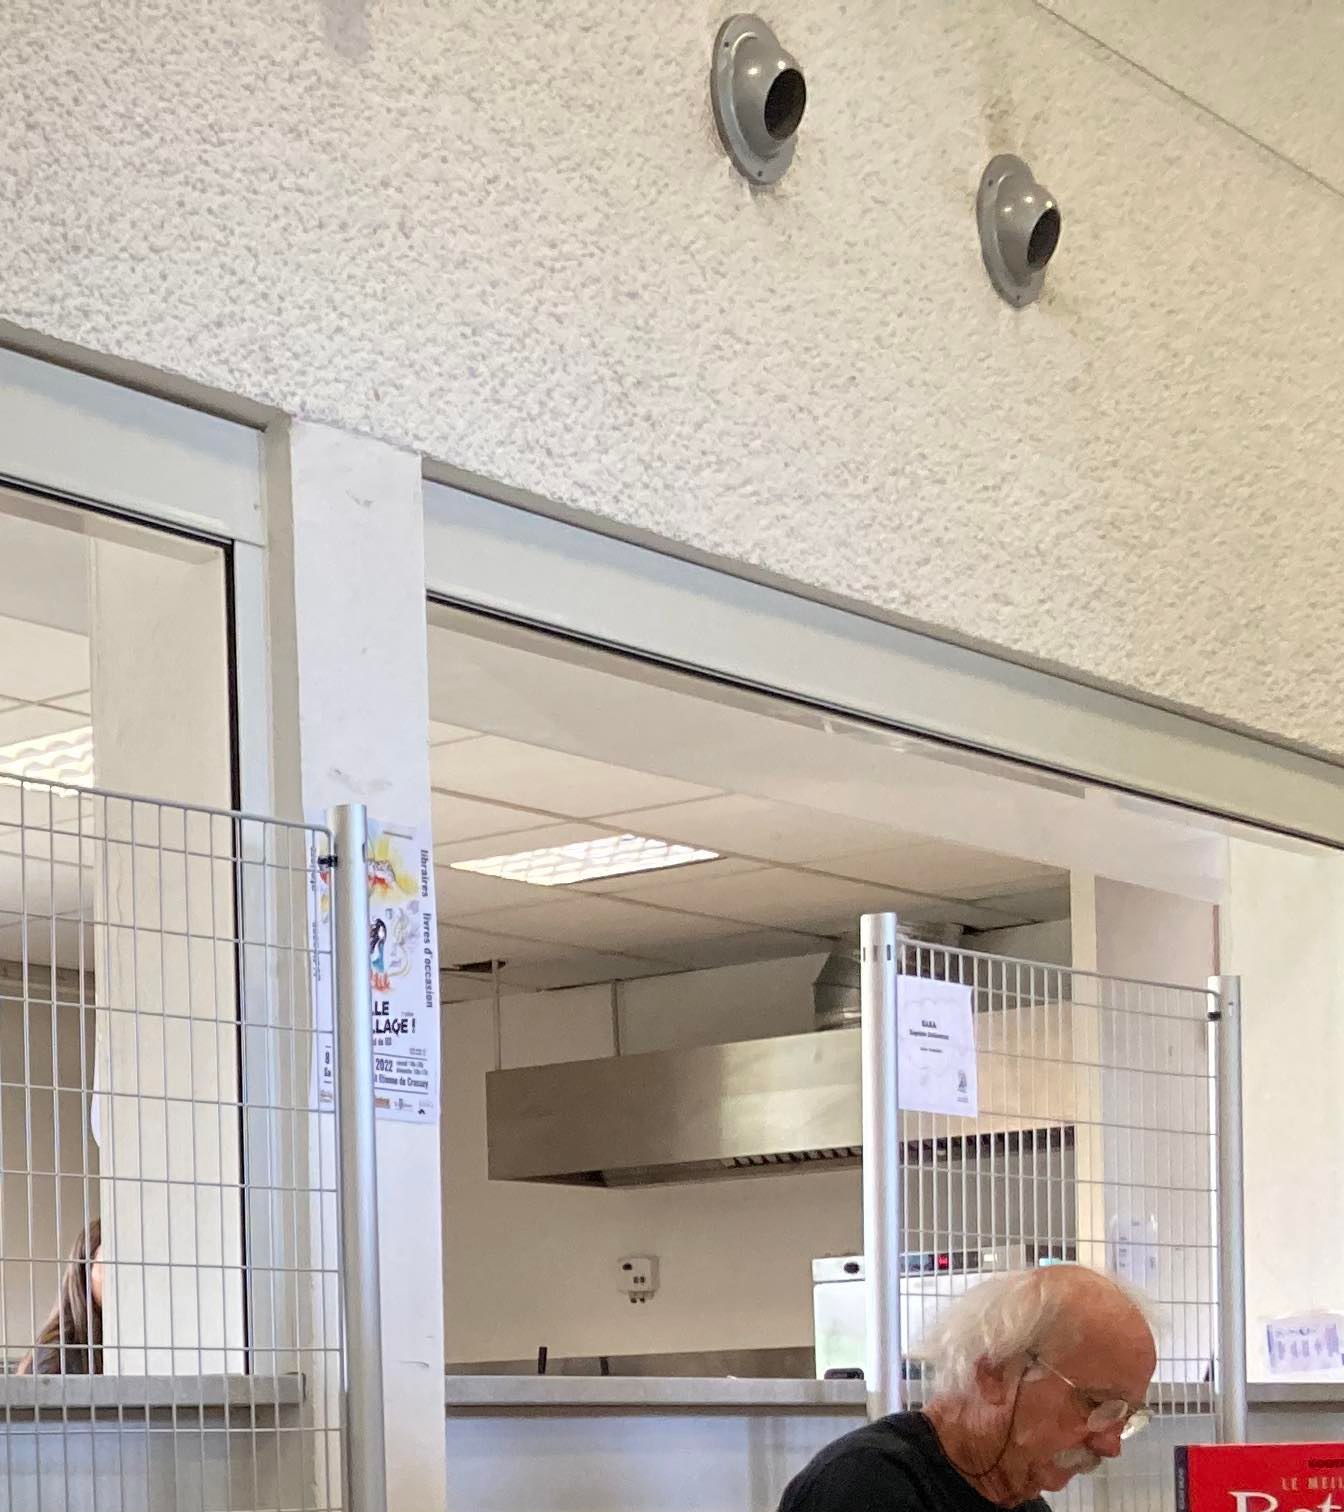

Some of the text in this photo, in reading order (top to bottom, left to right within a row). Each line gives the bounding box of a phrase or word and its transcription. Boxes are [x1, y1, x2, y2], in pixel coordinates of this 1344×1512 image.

[420, 849, 430, 898] libraires
[423, 912, 434, 1009] livres d'occasion
[375, 1057, 393, 1073] 2022
